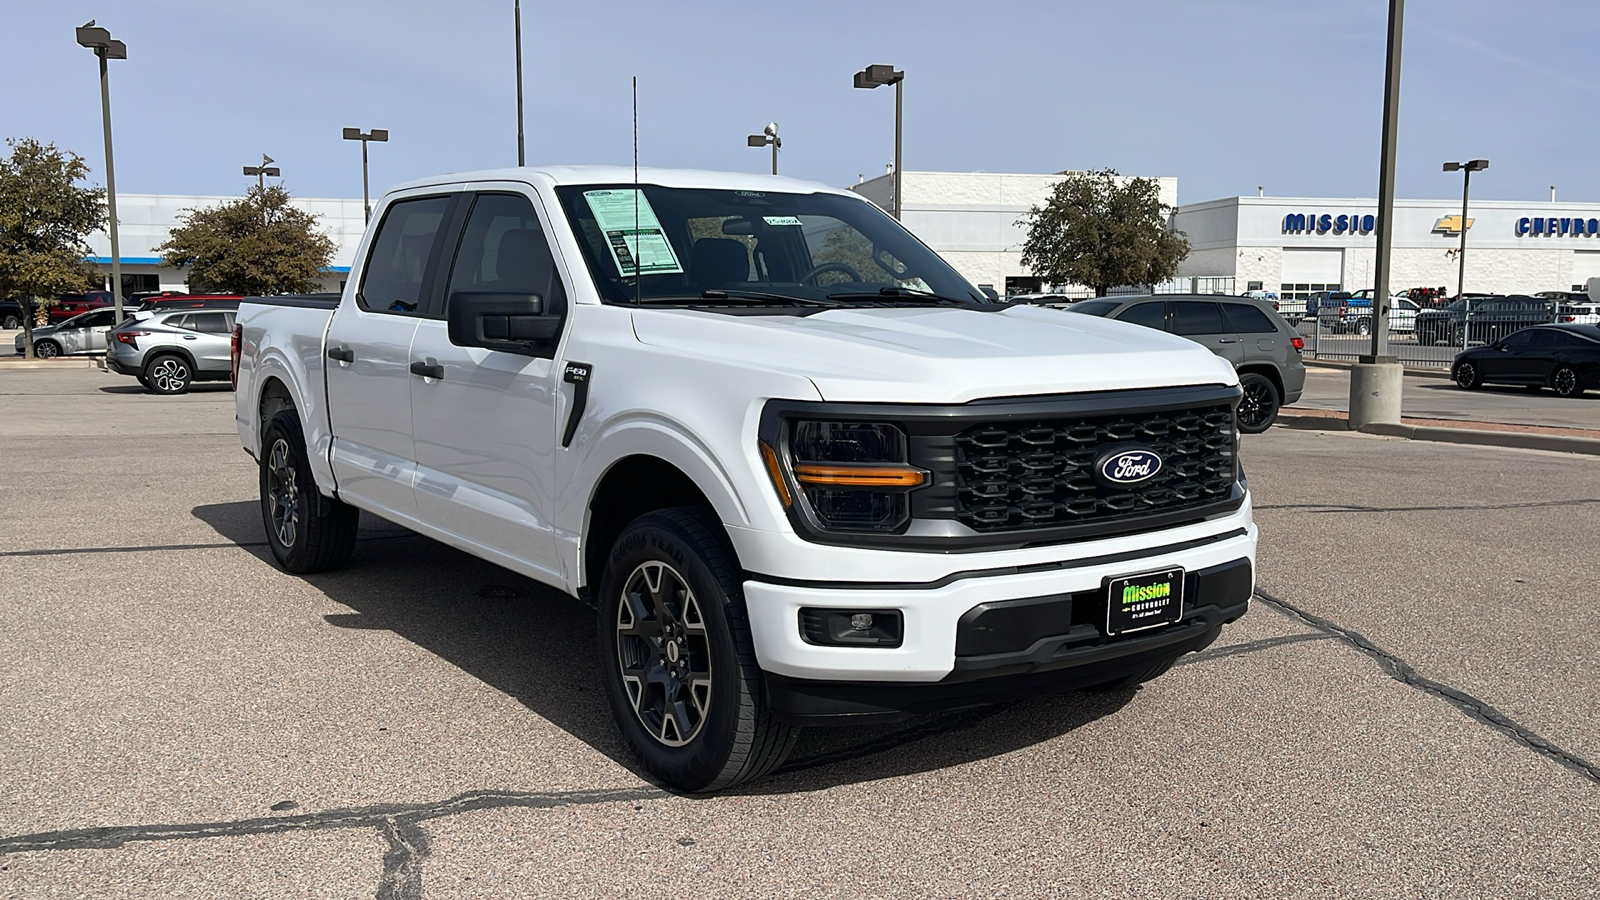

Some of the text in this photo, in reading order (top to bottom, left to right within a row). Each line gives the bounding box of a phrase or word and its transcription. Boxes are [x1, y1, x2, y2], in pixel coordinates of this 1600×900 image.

[1282, 213, 1600, 237] MISSIO CHEVRO
[1114, 455, 1151, 478] Ford
[1122, 582, 1171, 604] Mission
[1131, 598, 1170, 612] CHEVROLET
